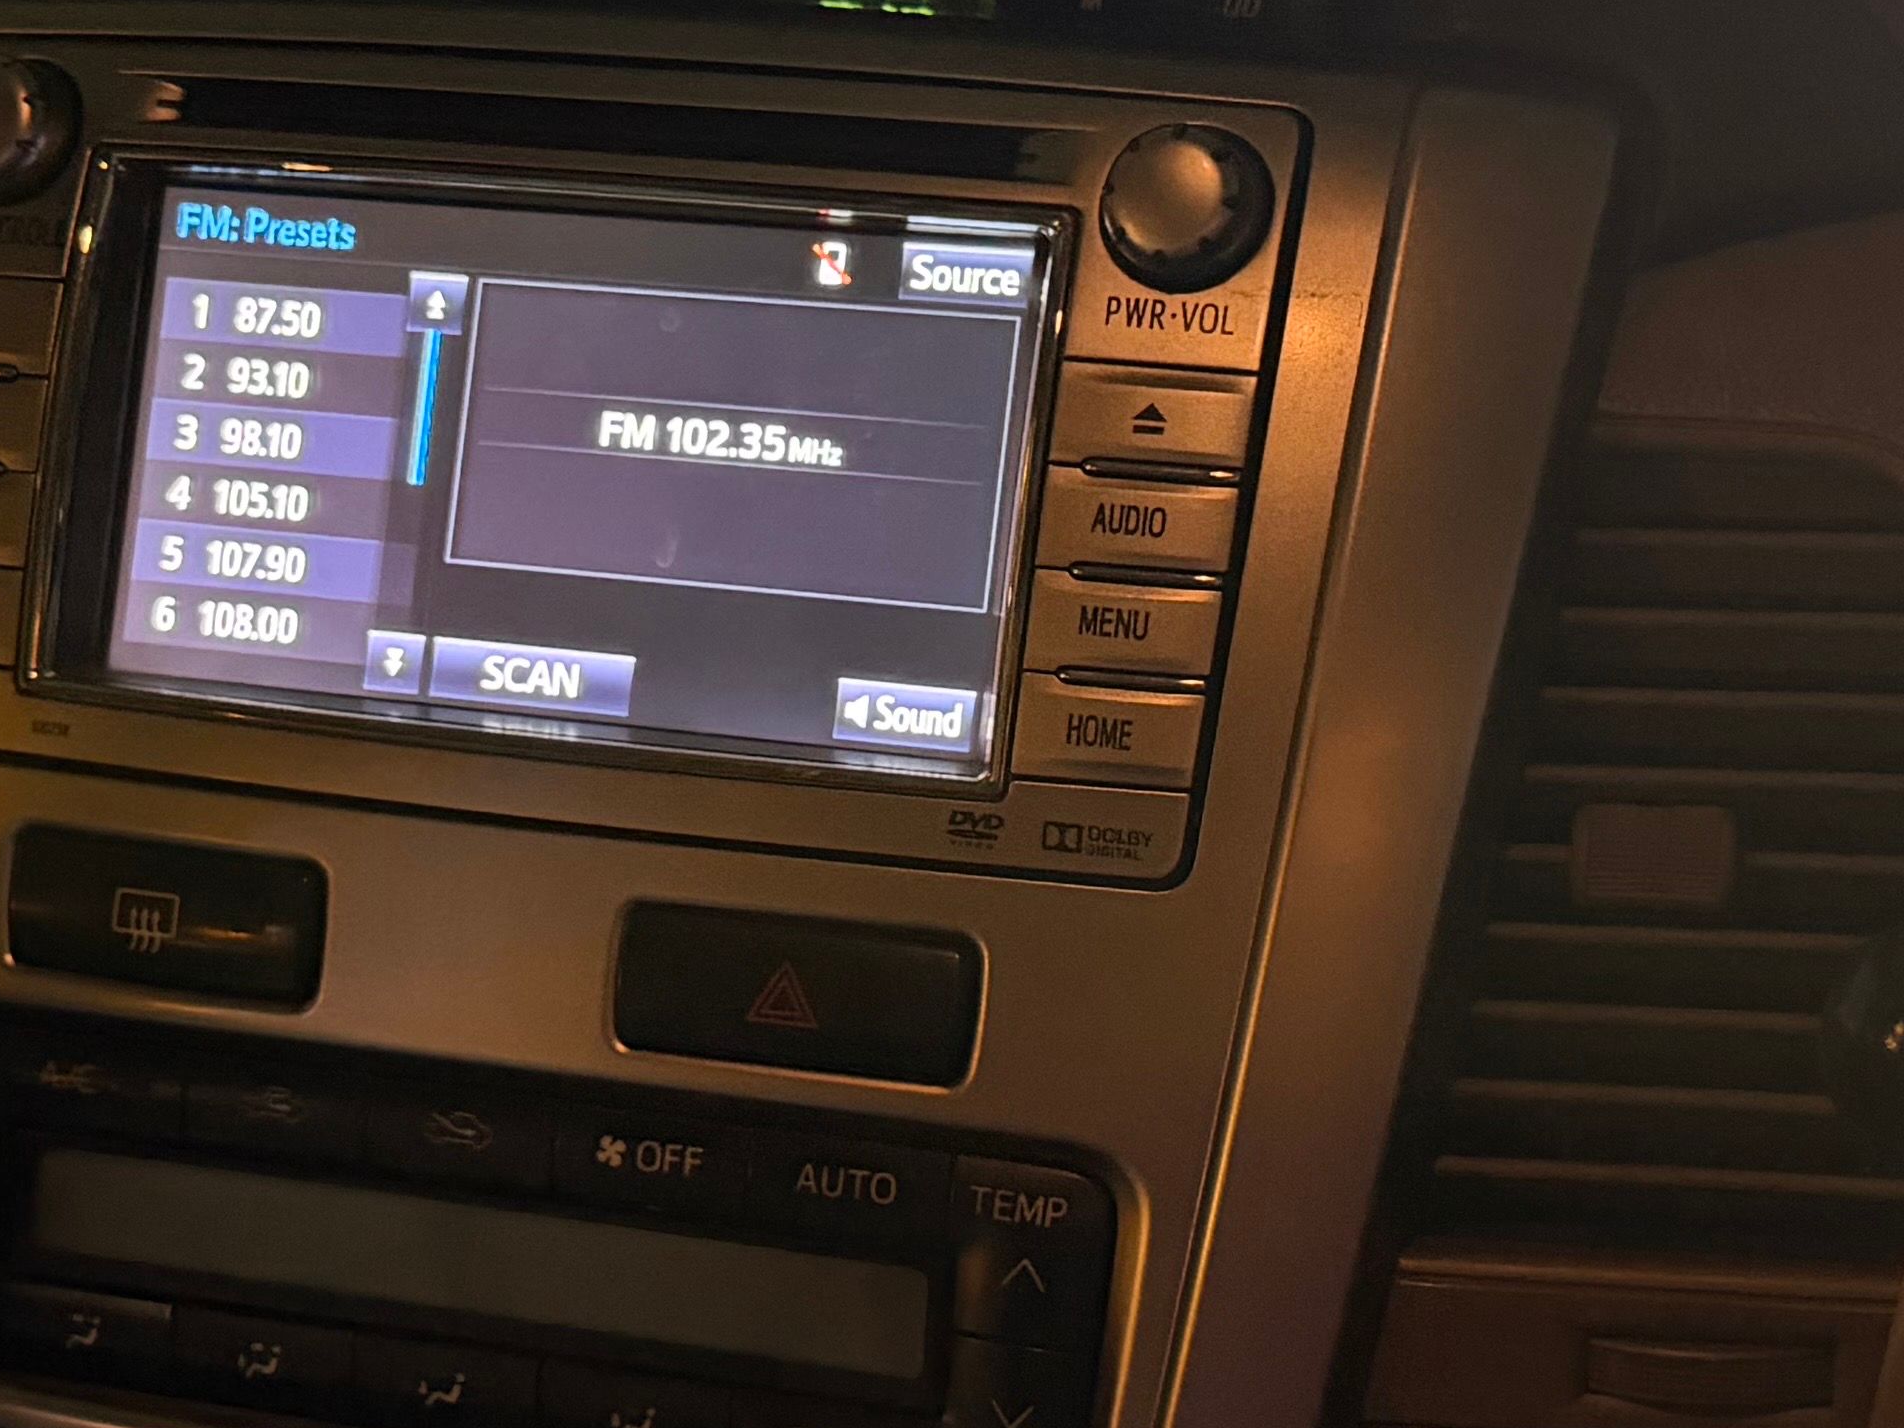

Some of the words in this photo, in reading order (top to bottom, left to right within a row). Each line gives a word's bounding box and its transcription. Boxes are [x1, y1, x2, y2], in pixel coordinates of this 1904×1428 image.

[176, 202, 240, 243] FM:
[243, 207, 358, 251] Presets
[909, 254, 1021, 297] Source
[192, 293, 210, 329] 1
[234, 296, 322, 339] 87.50
[180, 353, 206, 390] 2
[226, 356, 310, 399] 93.10
[173, 414, 199, 450] 3
[220, 418, 303, 460] 98.10
[598, 410, 657, 451] FM
[165, 475, 192, 511] 4
[213, 478, 309, 522] 105.10
[1091, 502, 1168, 539] AUDIO
[158, 535, 185, 572] 5
[206, 540, 307, 584] 107.90
[151, 596, 177, 632] 6
[198, 600, 299, 644] 108.00
[1078, 605, 1151, 642] MENU
[480, 655, 582, 699] SCAN
[873, 695, 964, 739] Sound
[1065, 712, 1133, 752] HOME
[948, 810, 1005, 830] DVD
[1088, 824, 1154, 848] DOLBY
[1087, 843, 1143, 861] DIGITAL
[635, 1138, 705, 1180] OFF
[795, 1162, 898, 1207] AUTO
[970, 1183, 1069, 1230] TEMP
